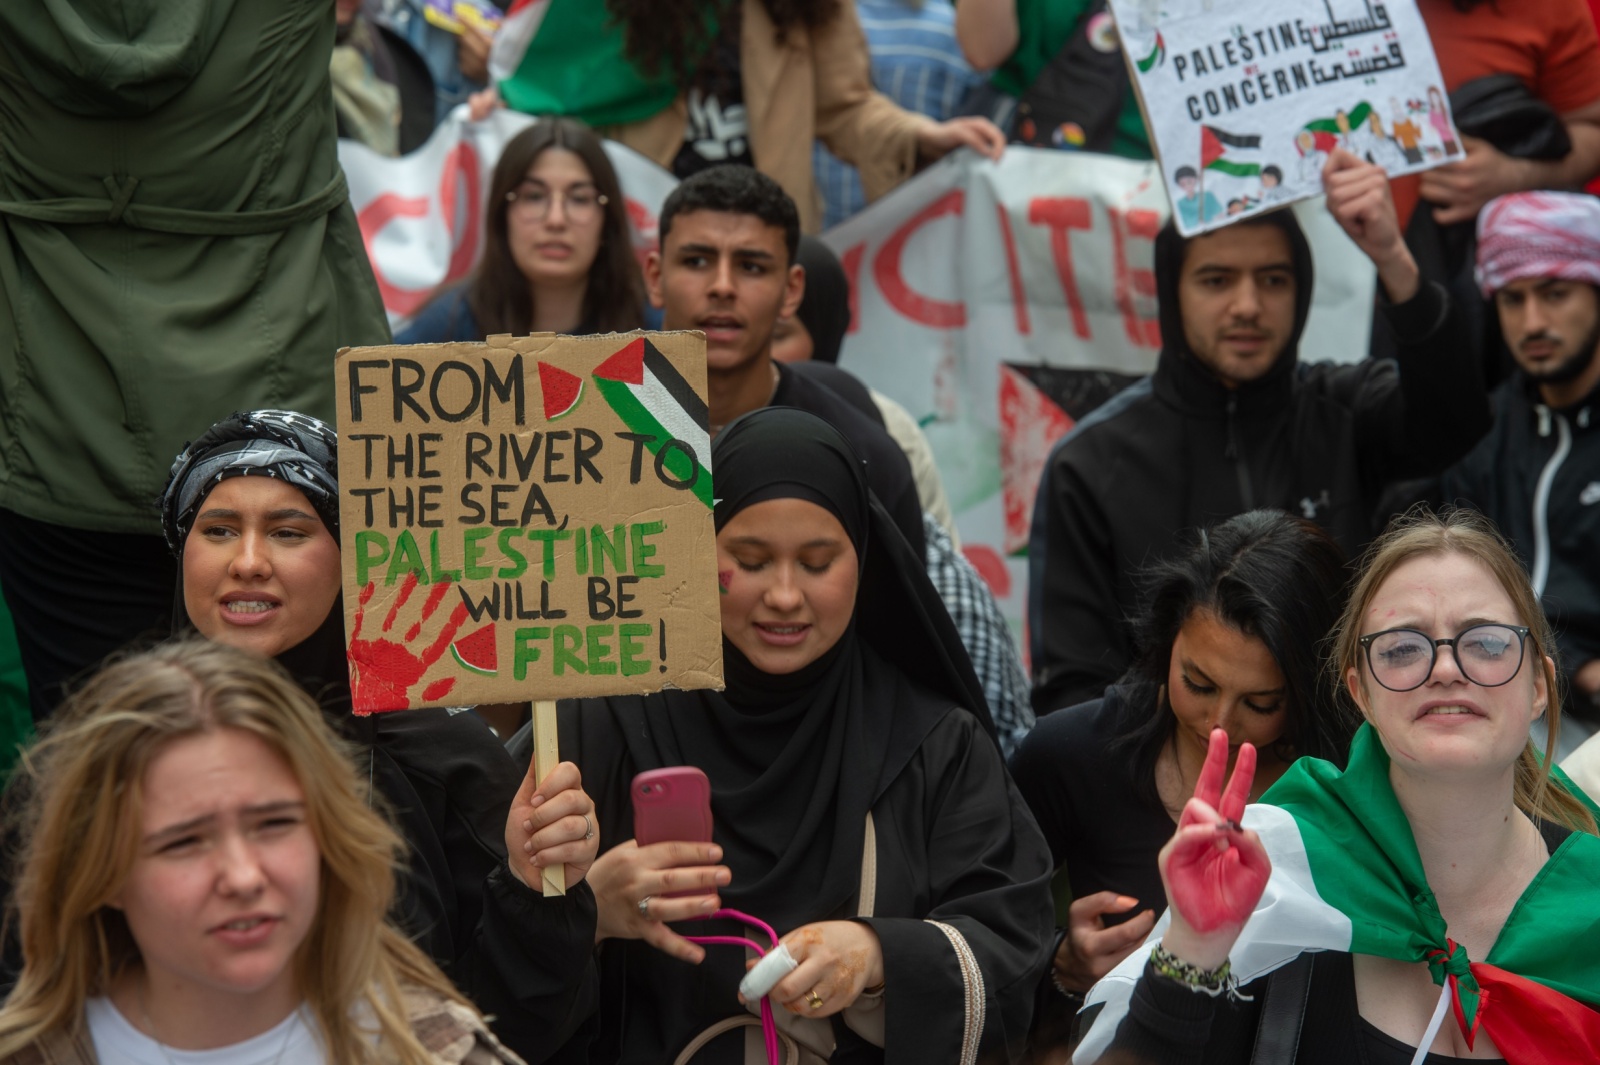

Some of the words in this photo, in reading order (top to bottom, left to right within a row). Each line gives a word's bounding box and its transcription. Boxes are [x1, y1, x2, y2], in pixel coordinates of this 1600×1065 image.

[1172, 18, 1310, 82] PALESTINE
[348, 353, 525, 426] FROM
[348, 432, 443, 480] THE
[465, 427, 604, 484] RIVER
[615, 431, 699, 490] TO
[349, 484, 444, 528] THE
[457, 483, 569, 531] SEA,
[354, 520, 668, 587] PALESTINE
[457, 580, 567, 622] WILL
[587, 576, 644, 620] BE
[513, 618, 667, 681] FREE!
